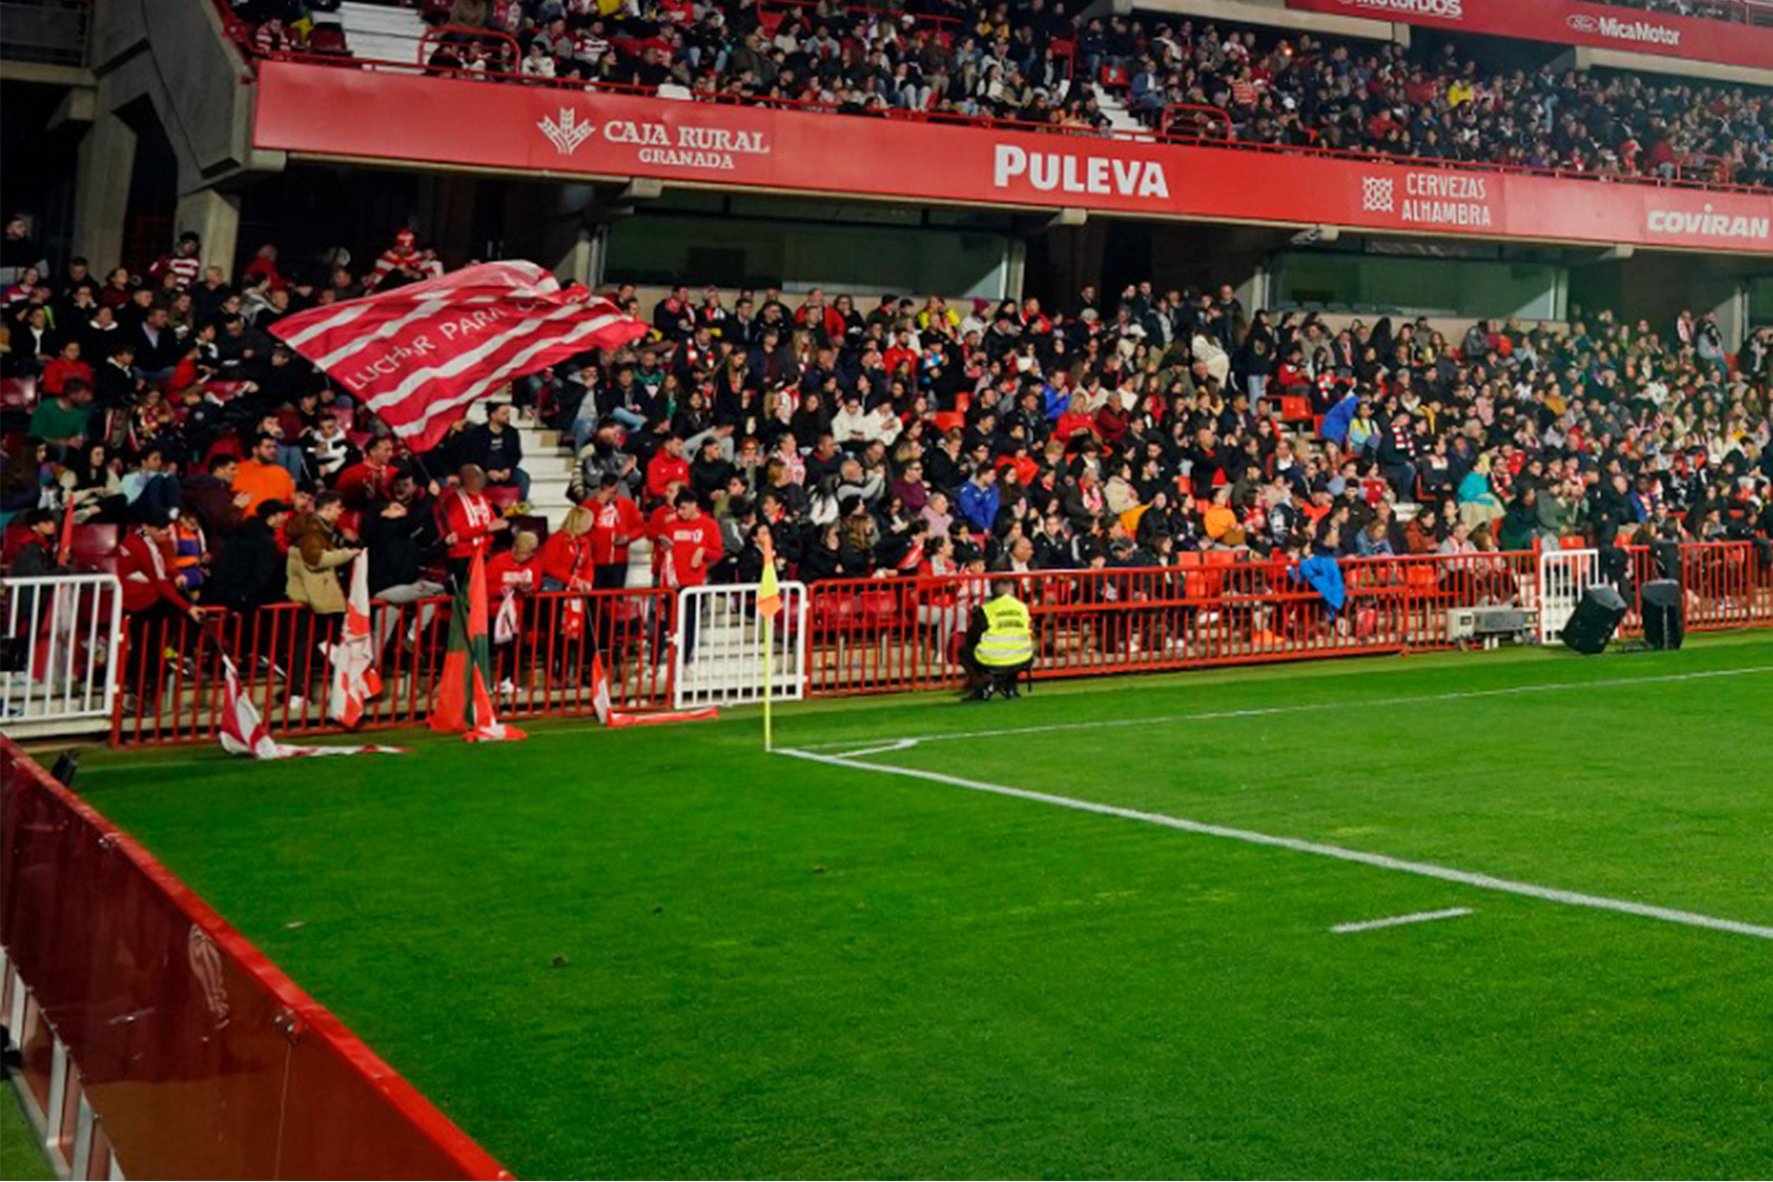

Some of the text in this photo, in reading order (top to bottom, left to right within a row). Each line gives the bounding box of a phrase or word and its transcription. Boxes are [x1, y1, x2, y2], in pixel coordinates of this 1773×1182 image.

[603, 120, 770, 154] CAJA RURAL
[639, 148, 734, 169] GRANADA
[994, 143, 1169, 198] PULEVA
[1406, 171, 1486, 199] CERVEZAS
[1402, 199, 1491, 226] ALHAMBRA
